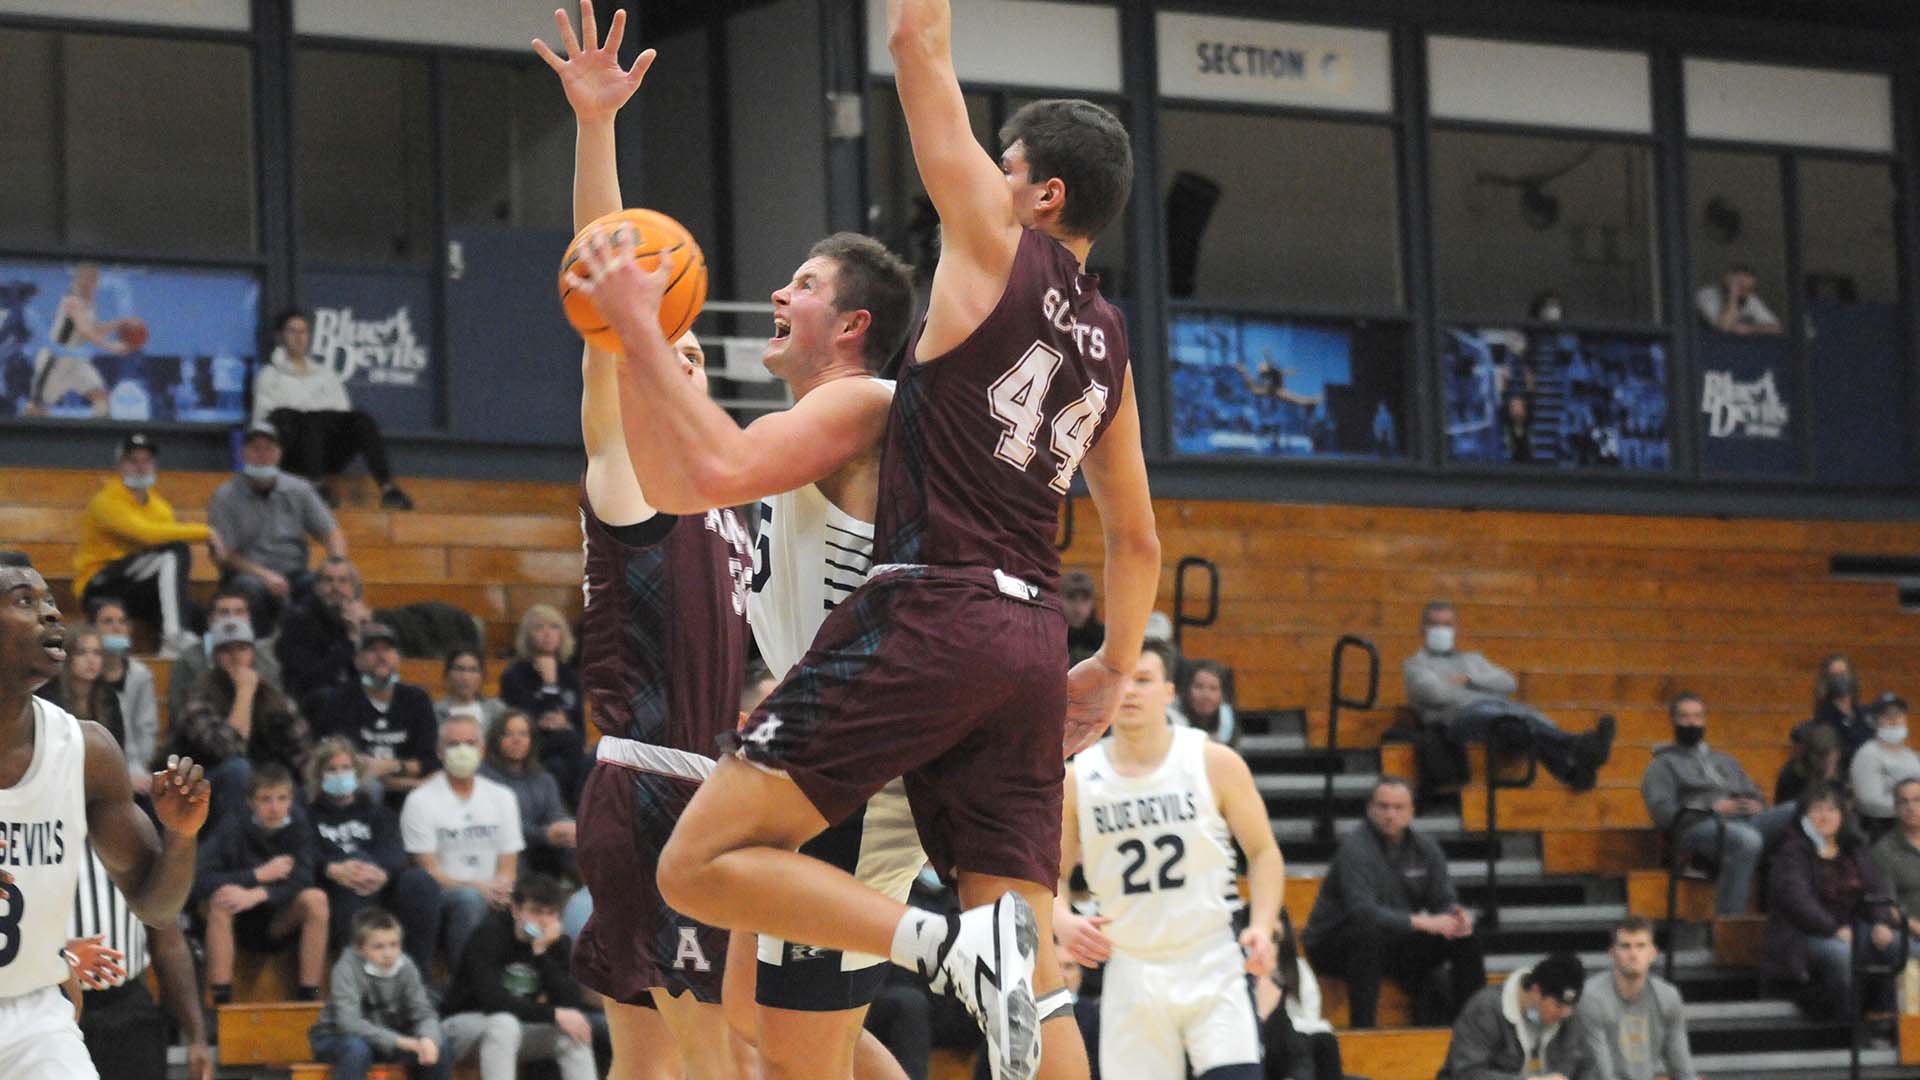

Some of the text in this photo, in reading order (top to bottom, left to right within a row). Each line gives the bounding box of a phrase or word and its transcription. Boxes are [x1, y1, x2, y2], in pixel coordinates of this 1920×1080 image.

[1197, 42, 1306, 80] SECTION
[311, 306, 392, 354] Blue
[1043, 287, 1106, 362] SCTS
[320, 336, 427, 379] Devils
[987, 339, 1109, 496] 44
[1093, 791, 1197, 835] BLUE DEVILS
[1116, 833, 1187, 895] 22
[672, 926, 712, 972] A
